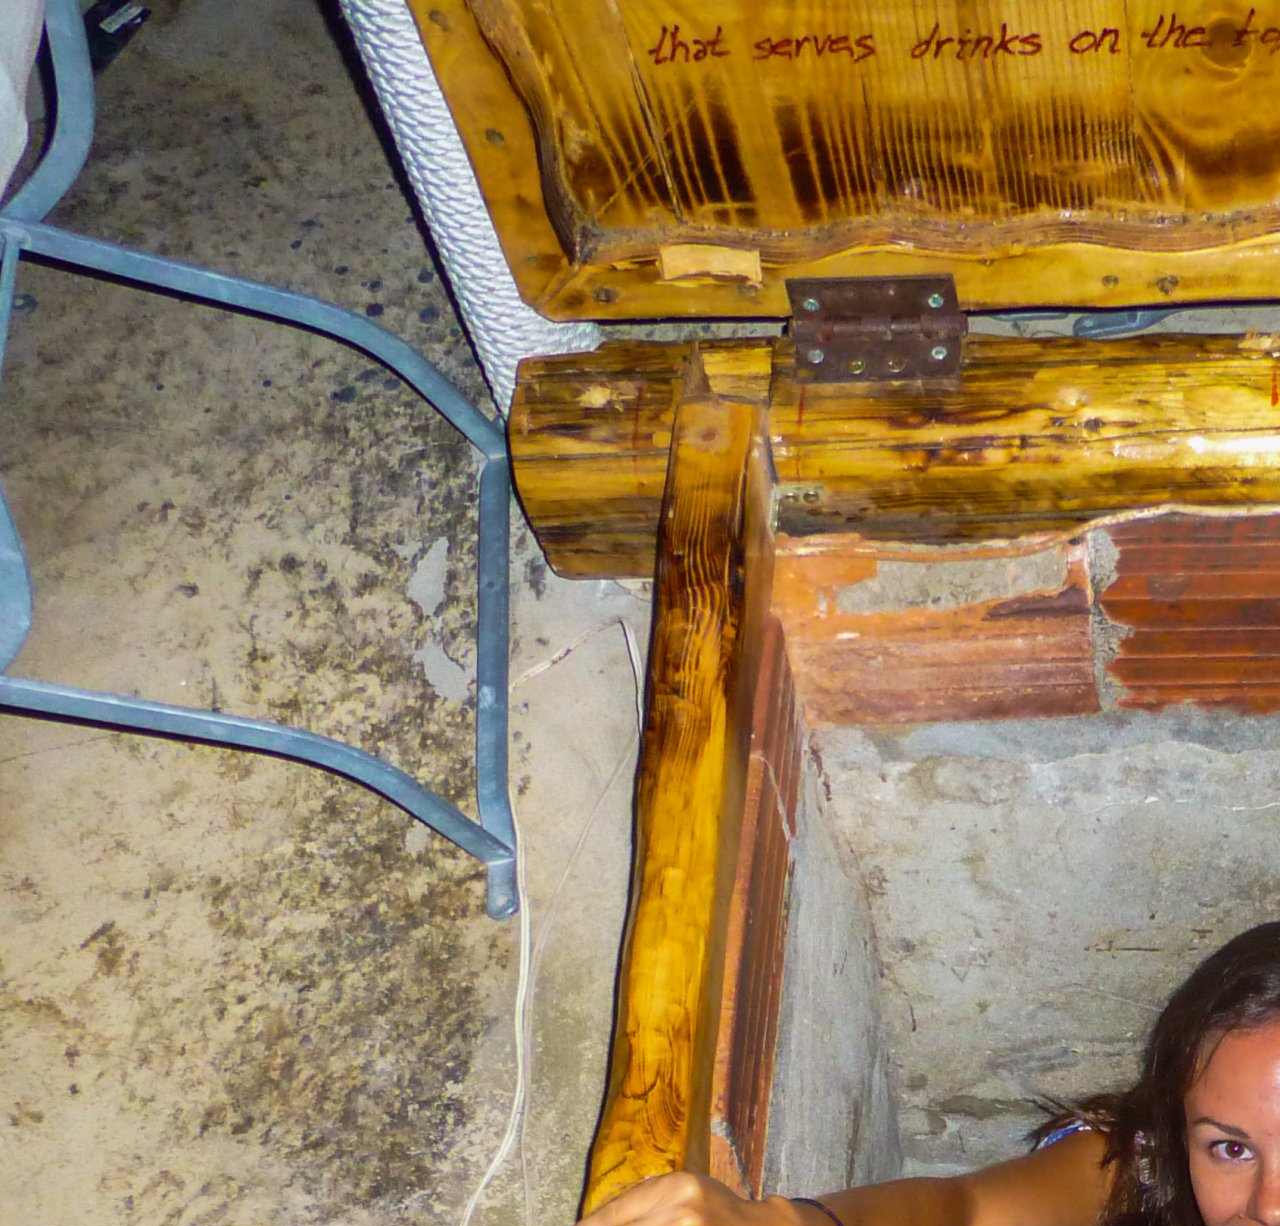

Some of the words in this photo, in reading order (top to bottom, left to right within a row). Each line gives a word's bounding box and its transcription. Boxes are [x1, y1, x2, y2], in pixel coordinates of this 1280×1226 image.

[648, 25, 731, 64] that
[752, 31, 876, 64] serves
[911, 23, 1042, 59] drinks
[1069, 29, 1121, 54] on
[1140, 14, 1208, 49] the
